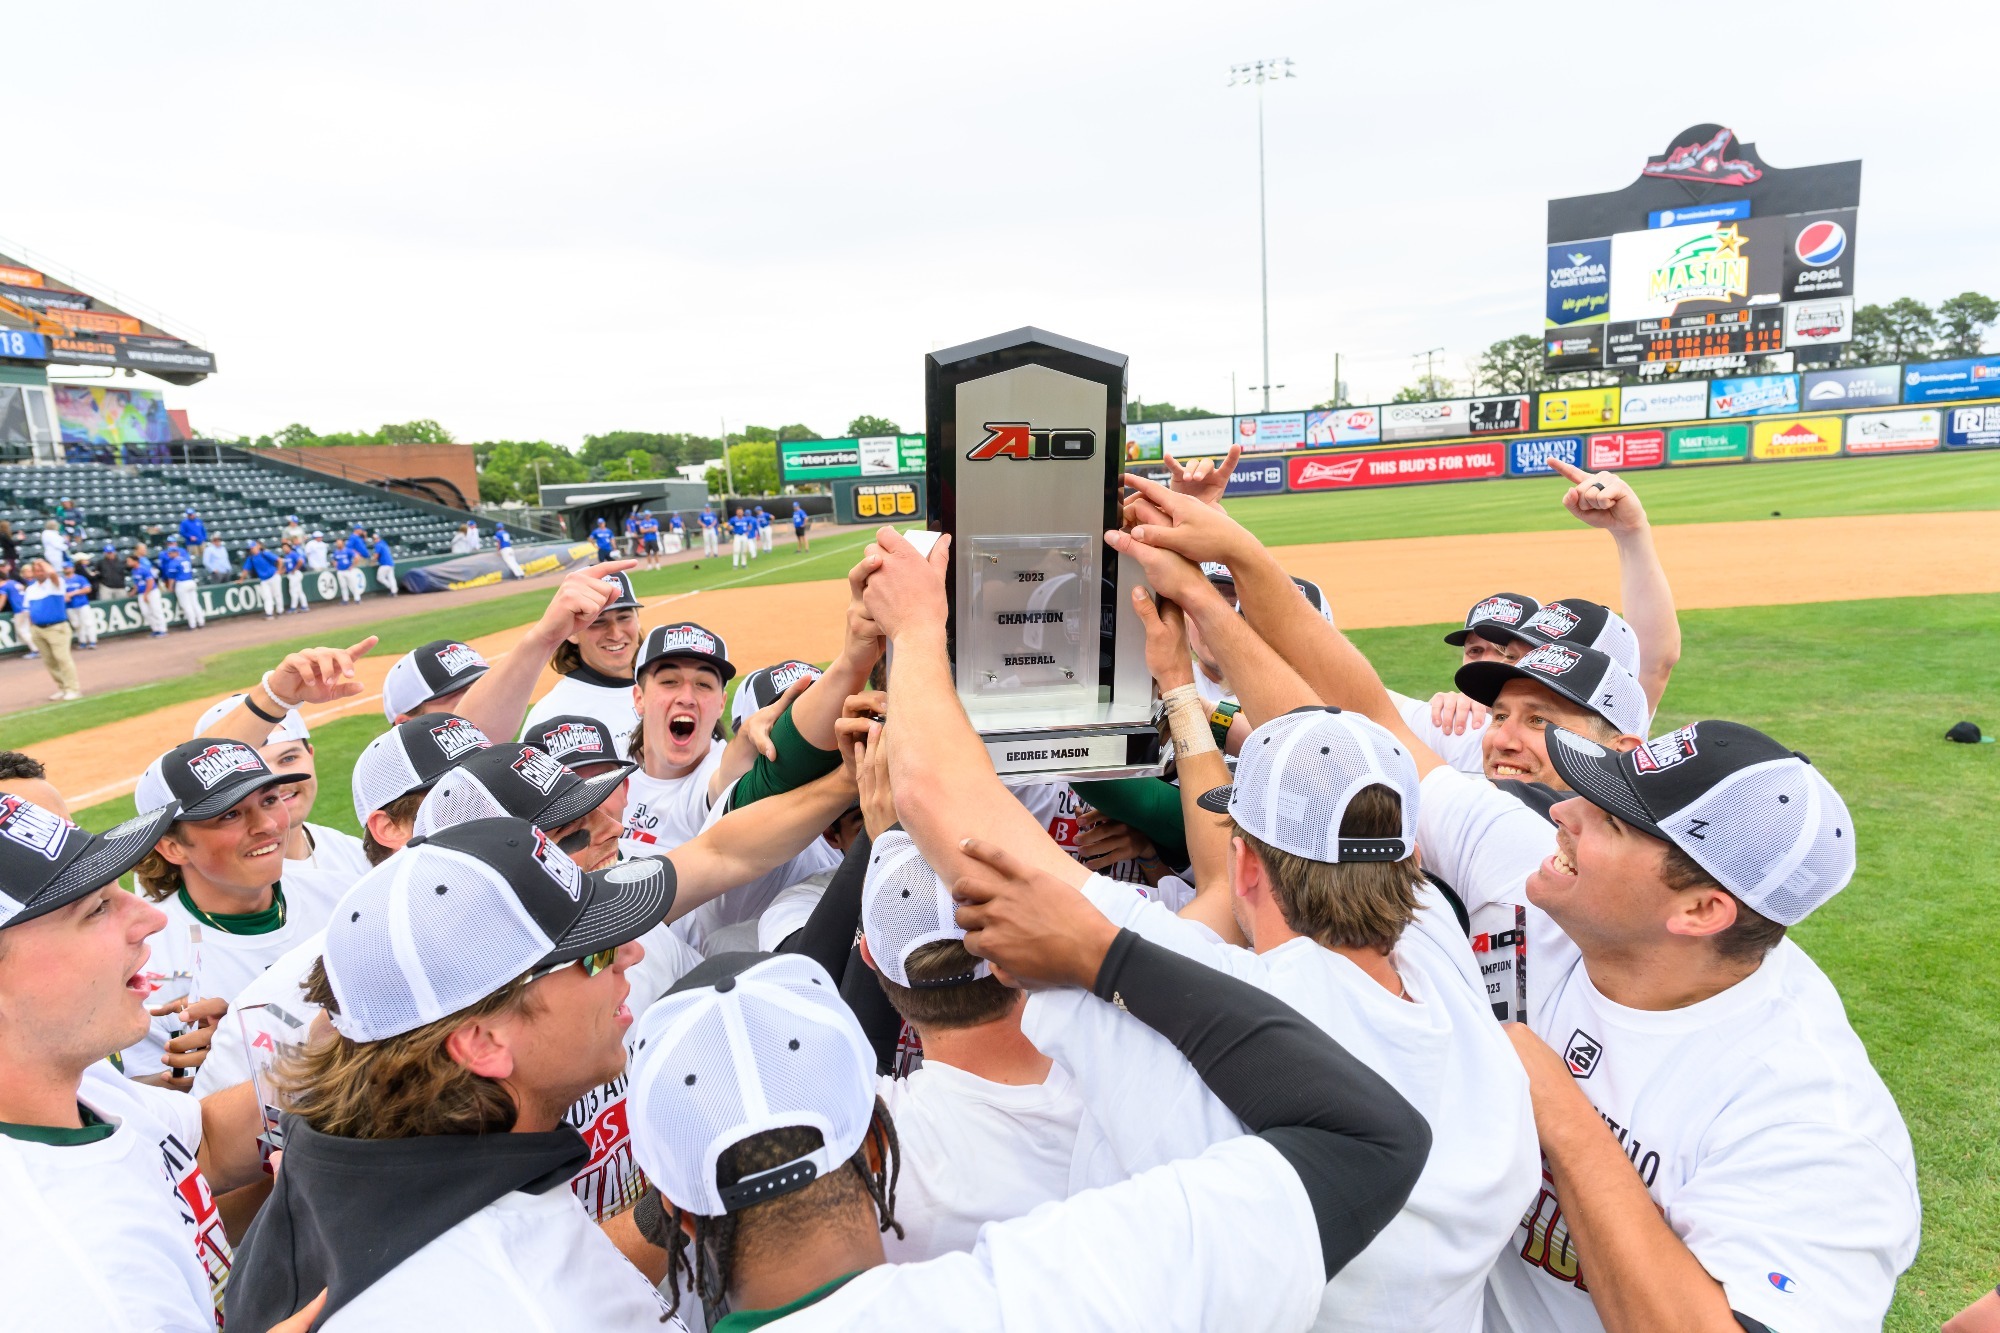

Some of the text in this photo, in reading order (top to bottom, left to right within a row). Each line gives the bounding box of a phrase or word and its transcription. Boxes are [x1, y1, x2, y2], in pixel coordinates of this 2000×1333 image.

[1550, 264, 1606, 280] VIRGINIA
[1649, 258, 1746, 299] MASON
[1798, 266, 1841, 285] pepsi
[1550, 275, 1607, 289] Credit Union
[1720, 312, 1738, 323] OUT
[0, 331, 27, 356] 18
[1638, 355, 1748, 377] VCU BASEBALL
[1848, 380, 1876, 389] APEX
[1650, 392, 1706, 405] elephant
[1848, 386, 1894, 398] SYSTEMS
[1349, 415, 1371, 427] DQ
[1475, 420, 1517, 431] MILLION
[1185, 427, 1230, 438] LANSING
[966, 421, 1097, 461] A10
[1516, 439, 1578, 456] DIAMOND
[1679, 435, 1729, 448] M&T Bank
[1765, 445, 1829, 456] PEST CONTROL
[787, 452, 859, 467] enterprise
[1369, 453, 1495, 476] THIS BUD'S FOR YOU.
[1229, 470, 1264, 483] RUIST
[1018, 572, 1045, 583] 2023
[997, 612, 1064, 626] CHAMPION
[666, 631, 715, 651] CHAMPIONS
[1004, 655, 1056, 667] BASEBALL
[1603, 694, 1614, 707] Z
[546, 729, 600, 756] CHAMPIONS
[1006, 747, 1090, 762] GEORGE MASON
[1637, 749, 1651, 769] 2023
[194, 749, 257, 782] CHAMPIONS
[1686, 818, 1710, 840] Z
[1480, 959, 1512, 976] AMPION
[1486, 982, 1501, 995] 023
